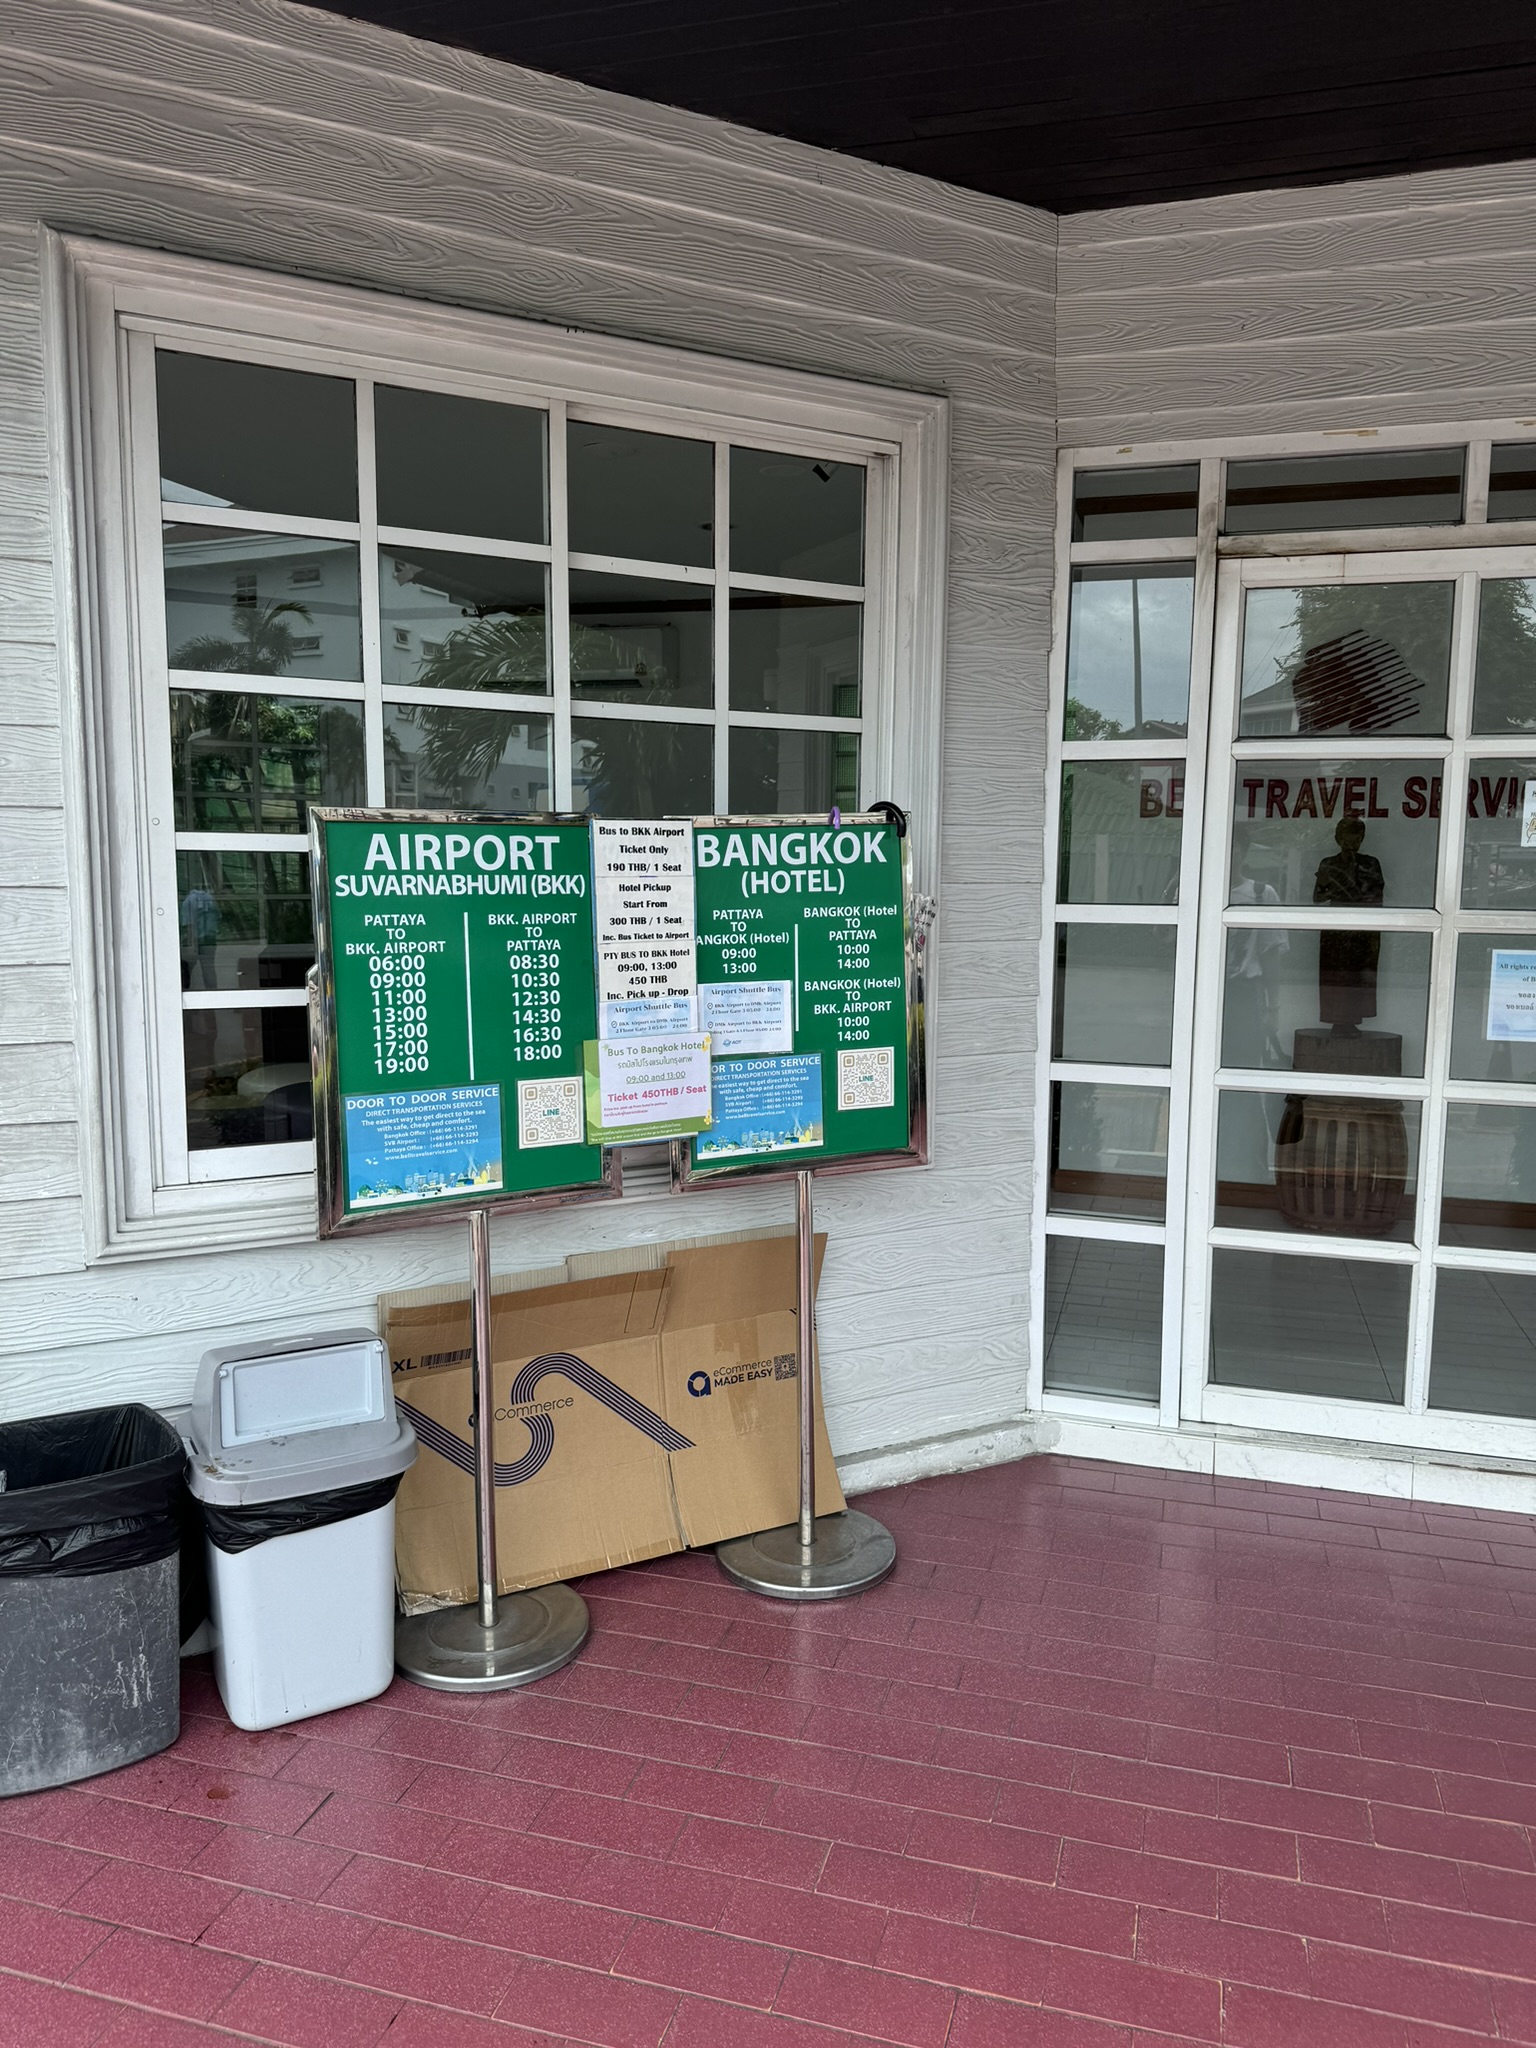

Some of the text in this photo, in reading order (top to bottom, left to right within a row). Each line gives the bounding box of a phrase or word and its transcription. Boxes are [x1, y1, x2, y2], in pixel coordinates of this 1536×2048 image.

[1139, 779, 1183, 819] BE
[1243, 777, 1389, 819] TRAVEL
[599, 826, 685, 838] Bus to BKK Airport
[364, 833, 560, 871] AIRPORT
[619, 844, 669, 855] Ticket Only
[697, 831, 887, 867] BANGKOK
[607, 863, 682, 873] 190 THB/ 1 Seat
[335, 874, 586, 897] SUVARNABHUMI (BKK)
[618, 884, 672, 893] Hotel Pickup
[741, 868, 845, 898] (HOTEL)
[623, 900, 668, 908] Start From
[713, 909, 763, 920] PATTAYA
[804, 905, 897, 918] BANGKOK (Hotel
[364, 914, 426, 927] PATTAYA
[488, 913, 577, 925] BKK. AIRPORT
[609, 917, 627, 926] 300
[629, 917, 647, 925] THB
[664, 916, 682, 924] Seat
[845, 918, 860, 928] TO
[525, 927, 543, 938] TO
[730, 921, 746, 932] TO
[386, 928, 406, 940] TO
[664, 932, 689, 940] Airport
[696, 932, 789, 945] ANGKOK (Hotel)
[829, 930, 877, 940] PATTAYA
[345, 941, 446, 955] BKK. AIRPORT
[507, 940, 561, 951] PATTAYA
[838, 944, 870, 955] 10:00
[603, 952, 619, 960] PTY
[621, 951, 637, 959] BUS
[651, 950, 668, 958] BKK
[670, 949, 690, 957] Hotel
[722, 948, 756, 959] 09:00
[369, 955, 425, 972] 06:00
[509, 954, 559, 970] 08:30
[651, 961, 677, 971] 13:00
[723, 962, 757, 974] 13:00
[838, 958, 870, 969] 14:00
[369, 972, 426, 989] 09:00
[511, 971, 560, 988] 10:30
[629, 975, 668, 985] 450 THB
[804, 977, 901, 991] BANGKOK (Hotel)
[371, 989, 426, 1006] 11:00
[607, 988, 689, 1000] Inc. Pick up Drop
[711, 988, 737, 996] Airport
[739, 986, 766, 994] Shuttle
[846, 991, 860, 1001] TO
[512, 990, 561, 1006] 12:30
[614, 1005, 642, 1014] Airport
[643, 1003, 672, 1011] Shuttle
[814, 1001, 892, 1014] BKK. AIRPORT
[372, 1006, 427, 1023] 13:00
[512, 1008, 561, 1025] 14:30
[838, 1016, 870, 1027] 10:00
[373, 1023, 428, 1040] 15:00
[513, 1026, 562, 1043] 16:30
[838, 1030, 870, 1041] 14:00
[374, 1040, 428, 1057] 17:00
[513, 1044, 562, 1061] 18:00
[607, 1041, 705, 1057] Bus To Bangkok Hotel
[374, 1056, 429, 1075] 19:00
[711, 1056, 821, 1074] OR TO DOOR SERVICE
[626, 1071, 686, 1083] 09:00 and 13:00
[731, 1070, 781, 1080] TRANSPORTATION
[781, 1068, 807, 1076] SERVICES
[347, 1087, 499, 1110] DOOR TO DOOR SERVICE
[607, 1093, 638, 1103] Ticket
[642, 1089, 679, 1099] 450THB
[686, 1085, 707, 1094] Seat
[365, 1100, 483, 1118] DIRECT TRANSPORTATION SERVICES
[543, 1108, 560, 1116] LINE
[375, 1117, 399, 1125] easiest
[400, 1116, 414, 1124] way
[423, 1114, 434, 1122] get
[435, 1111, 454, 1120] direct
[411, 1121, 430, 1130] cheap
[445, 1117, 472, 1126] comfort.
[392, 1358, 417, 1373] XL
[713, 1360, 772, 1377] eCommerce
[714, 1368, 773, 1387] MADE EASY
[494, 1396, 574, 1421] Commerce
